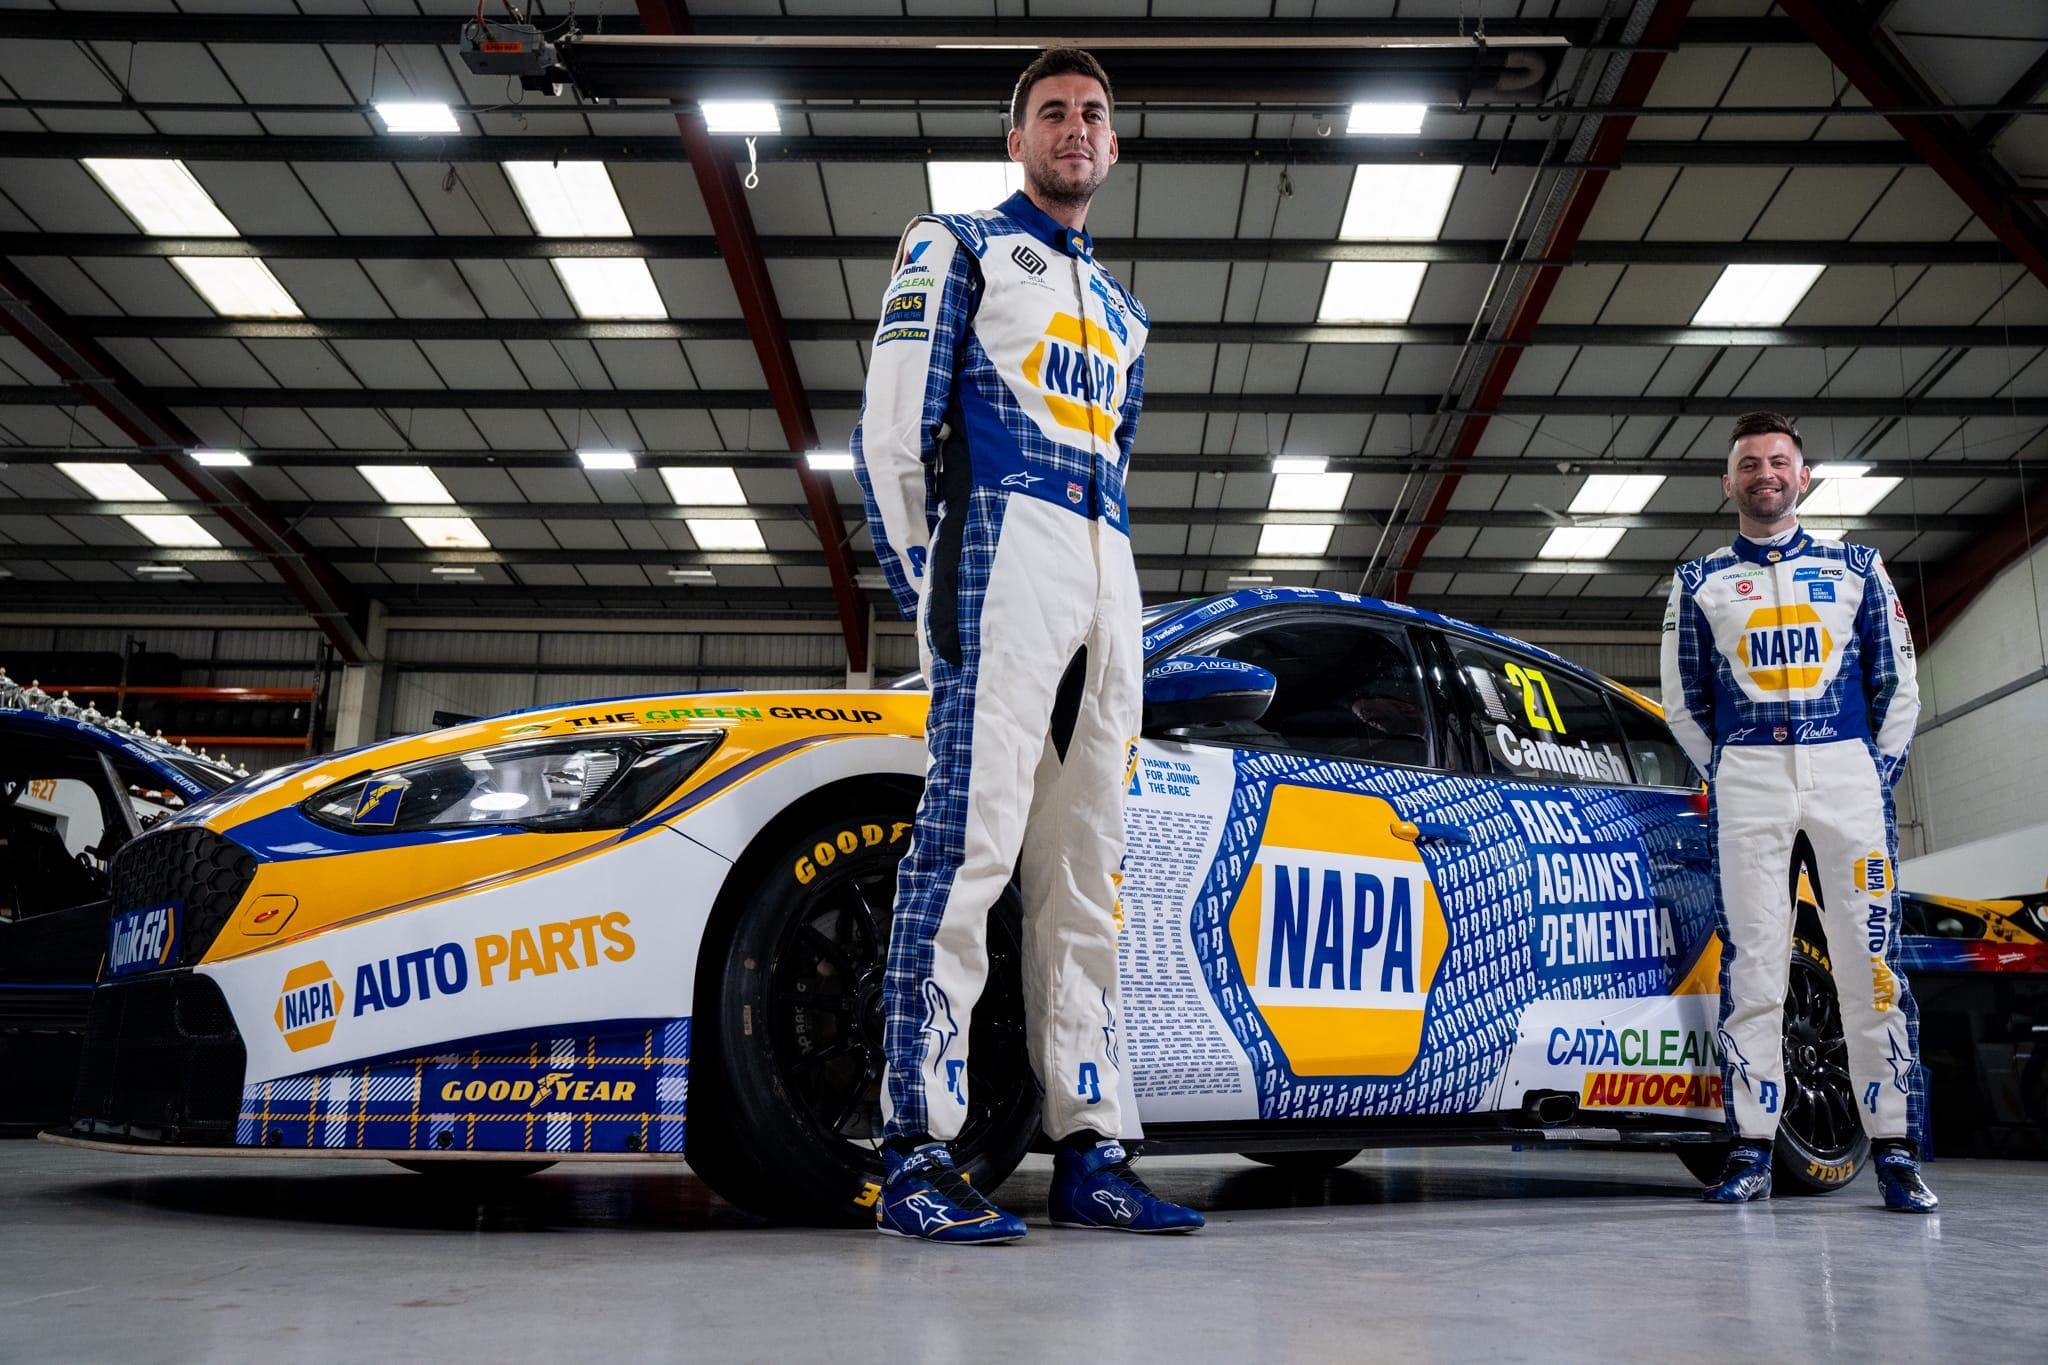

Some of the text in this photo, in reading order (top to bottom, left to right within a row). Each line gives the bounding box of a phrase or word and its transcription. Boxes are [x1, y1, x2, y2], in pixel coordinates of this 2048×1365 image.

[886, 295, 922, 315] ZEUS
[1045, 342, 1117, 417] NAPA
[1723, 570, 1765, 580] CATACLEAN
[1750, 626, 1820, 667] NAPA
[1151, 661, 1250, 677] ROAD ANGEL
[565, 711, 636, 728] THE
[645, 706, 762, 720] GREEN
[769, 706, 883, 724] GROUP
[1504, 661, 1567, 735] 27
[1142, 757, 1192, 772] THANK YOU
[1495, 723, 1635, 784] Cammish
[31, 779, 58, 802] #27
[1145, 769, 1200, 785] FOR JOINING
[1148, 782, 1192, 797] THE RACE
[1514, 799, 1592, 844] RACE
[794, 822, 884, 885] GOOD
[1535, 852, 1646, 905] AGAINST
[1867, 858, 1886, 891] NAPA
[1268, 864, 1415, 994] NAPA
[1541, 908, 1677, 968] DEMENTIA
[1866, 904, 1888, 953] AUTO
[283, 911, 636, 1031] NAPA AUTO PARTS
[1548, 1026, 1724, 1067] CATACLEAN
[441, 1072, 637, 1108] GOODYEAR
[1586, 1073, 1724, 1110] AUTOCAR
[1806, 1160, 1855, 1184] EAGLE
